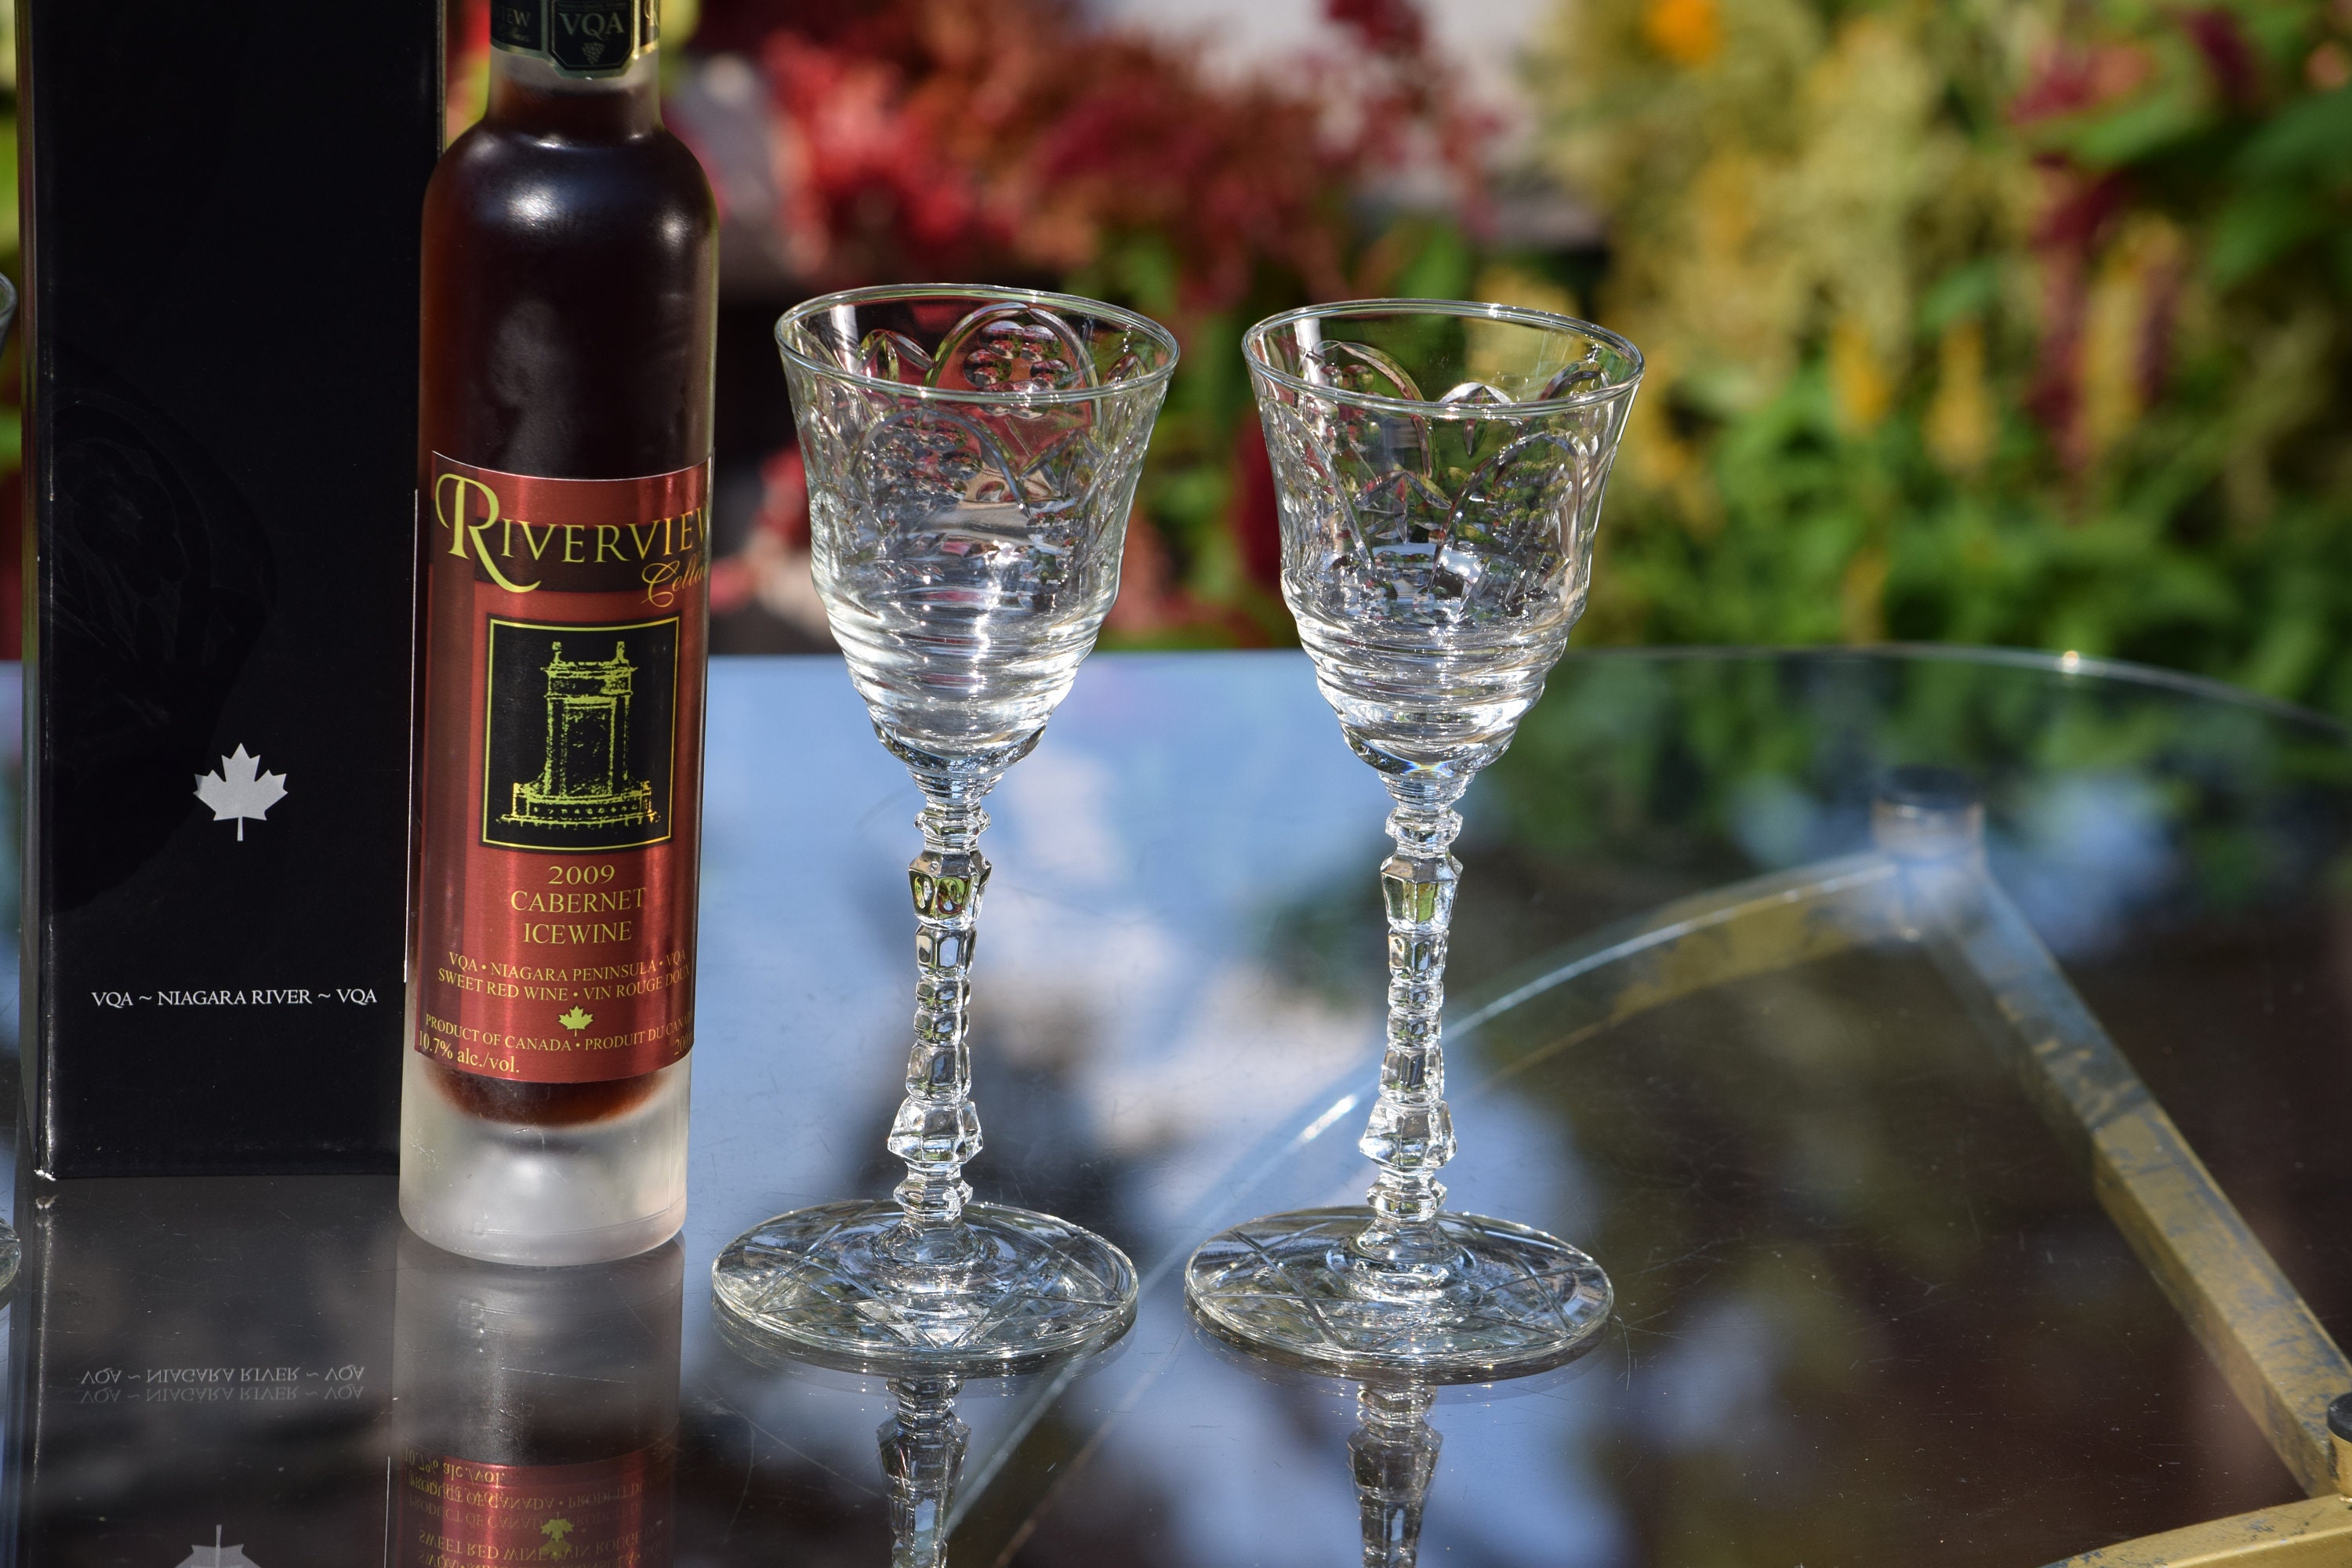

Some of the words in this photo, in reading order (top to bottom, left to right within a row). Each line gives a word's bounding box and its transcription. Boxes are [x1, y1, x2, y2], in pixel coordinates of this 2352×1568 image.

[559, 11, 626, 41] VQA
[641, 551, 706, 608] Cella
[549, 865, 615, 884] 2009
[510, 887, 646, 913] CABERNET
[523, 920, 632, 945] ICEWINE
[448, 952, 477, 972] VQA
[491, 962, 568, 982] NIAGARA
[573, 959, 657, 982] PENINSULA
[666, 948, 686, 967] VQA
[91, 991, 133, 1008] VQA
[158, 990, 247, 1007] NIAGARA
[251, 989, 313, 1005] RIVER
[336, 989, 378, 1006] VQA
[438, 967, 483, 992] SWEET
[486, 981, 519, 998] RED
[523, 985, 568, 1001] WINE
[583, 986, 611, 1000] VIN
[616, 976, 662, 997] ROUGE
[426, 1014, 480, 1042] PRODUCT
[482, 1032, 501, 1046] OF
[505, 1036, 572, 1051] CANADA
[585, 1031, 645, 1051] PRODUIT
[648, 1025, 664, 1041] DU
[419, 1030, 453, 1059] 10.7%
[457, 1048, 520, 1073] alc./vol.
